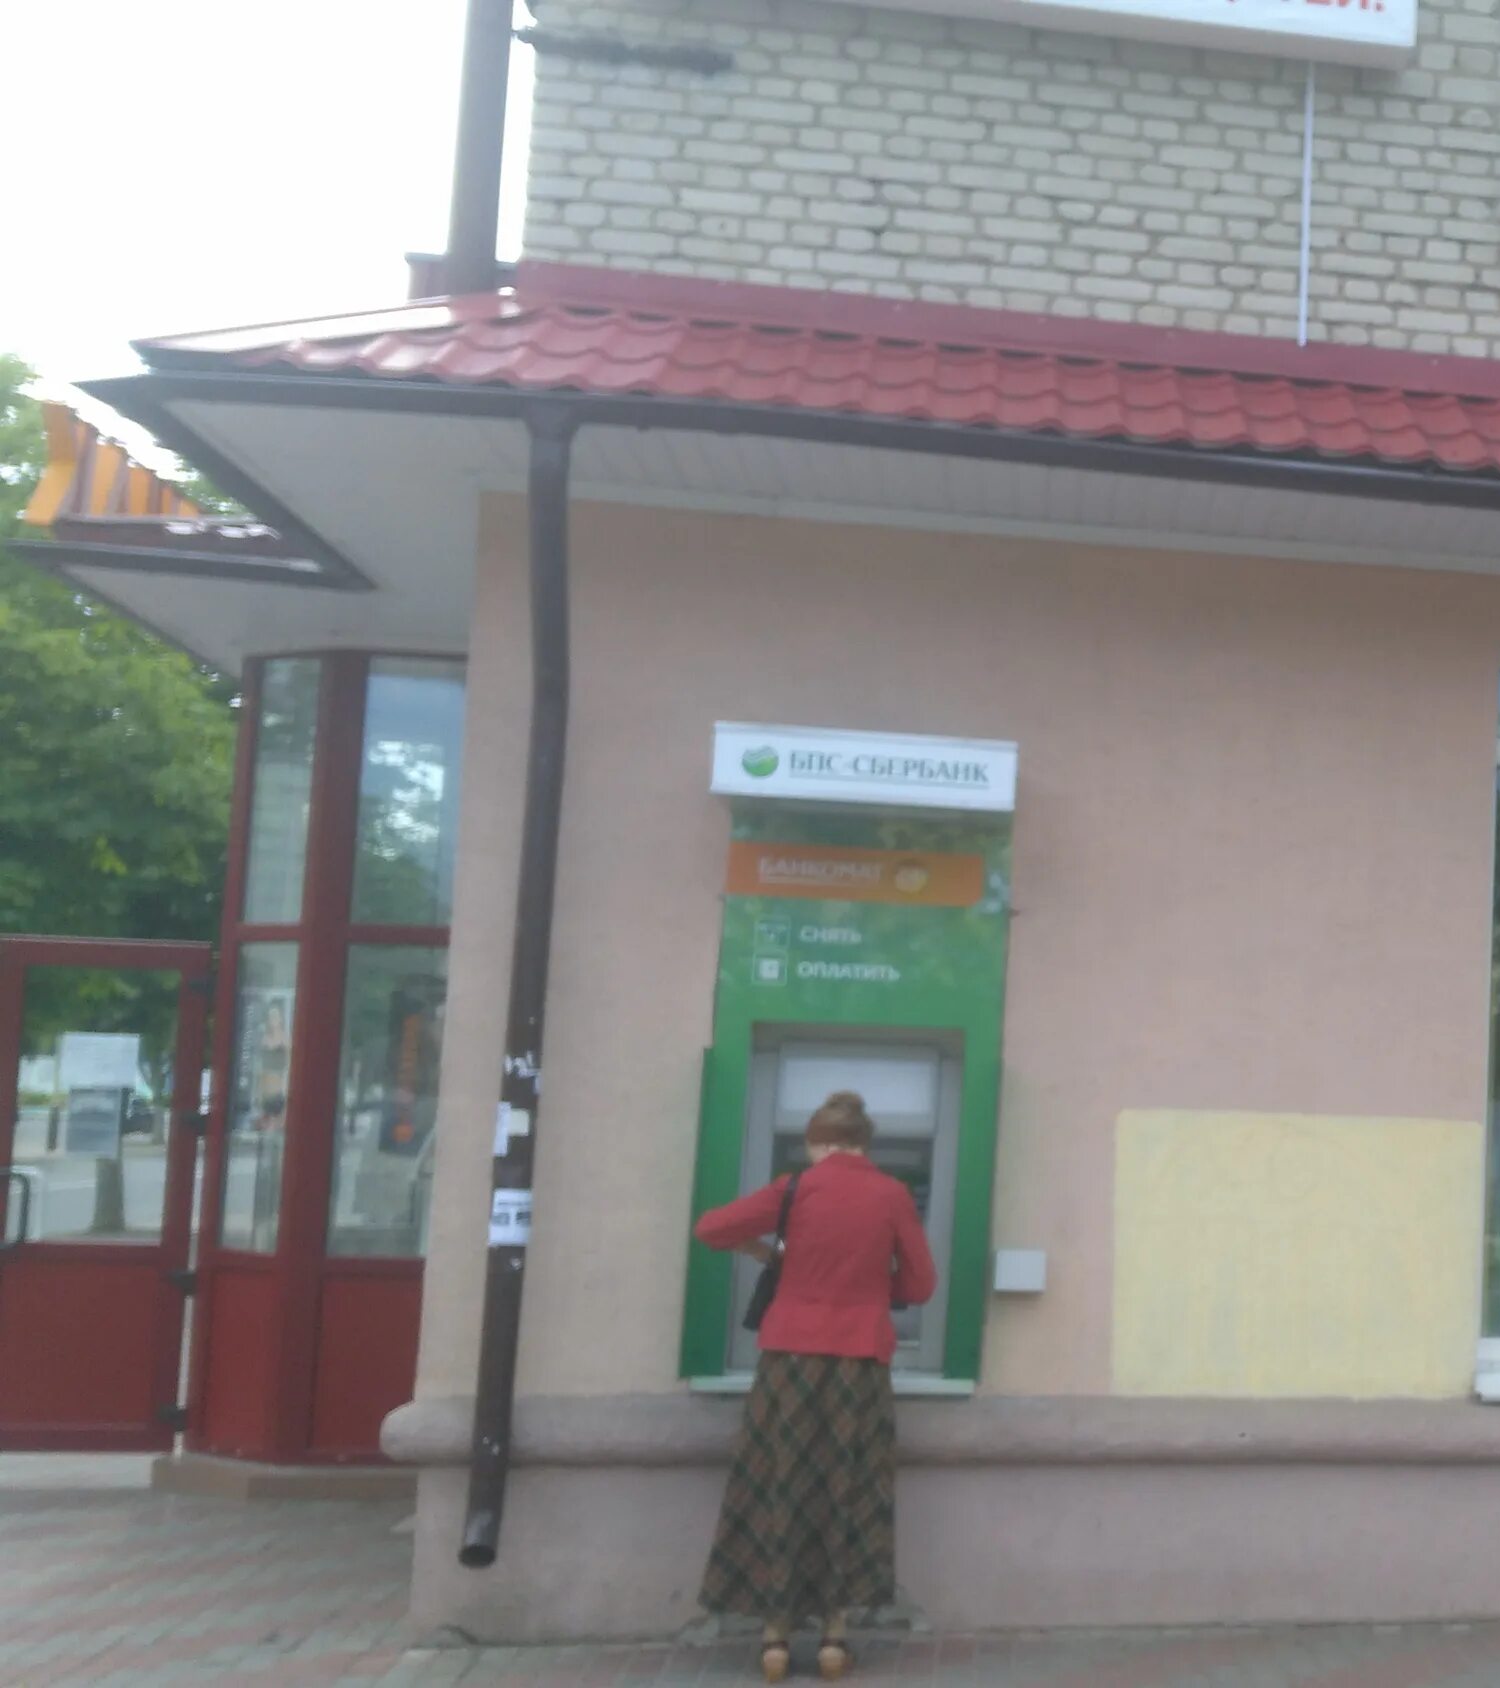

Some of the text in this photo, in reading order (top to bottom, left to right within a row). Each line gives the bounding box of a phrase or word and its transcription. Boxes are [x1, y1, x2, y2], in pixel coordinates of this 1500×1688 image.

[789, 750, 990, 784] БПС-СБЕРБАНК
[800, 925, 862, 944] СНЯТЬ
[797, 960, 900, 982] ОПЛАТИТЬ
